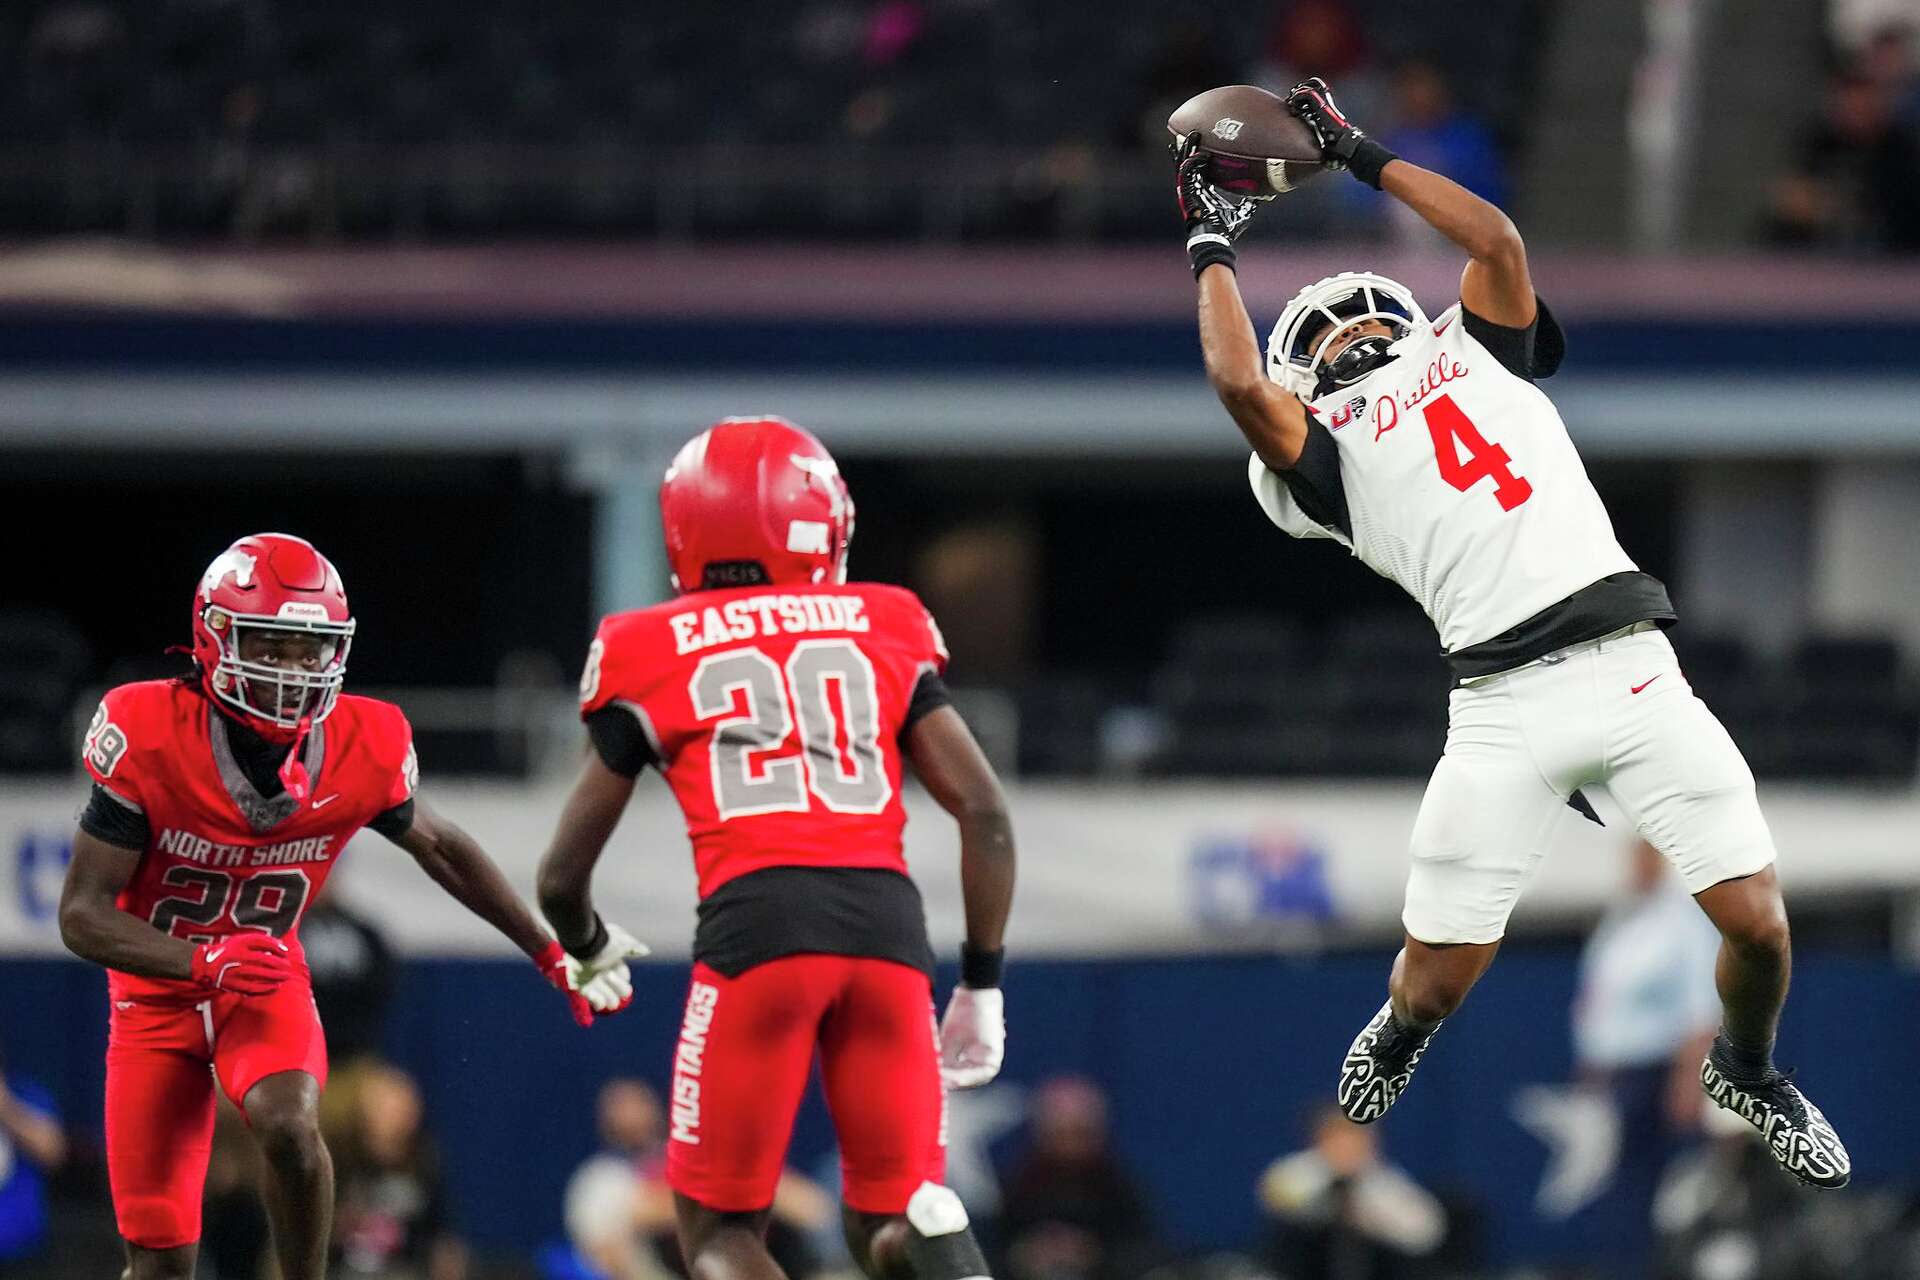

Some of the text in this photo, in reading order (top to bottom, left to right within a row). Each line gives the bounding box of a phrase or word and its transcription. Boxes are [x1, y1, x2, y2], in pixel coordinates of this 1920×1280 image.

[1422, 393, 1533, 512] 4
[669, 594, 870, 656] EASTSIDE
[688, 637, 893, 822] 20
[158, 828, 335, 866] NORTH SHORE
[150, 865, 311, 944] 29
[671, 981, 718, 1145] MUSTANGS
